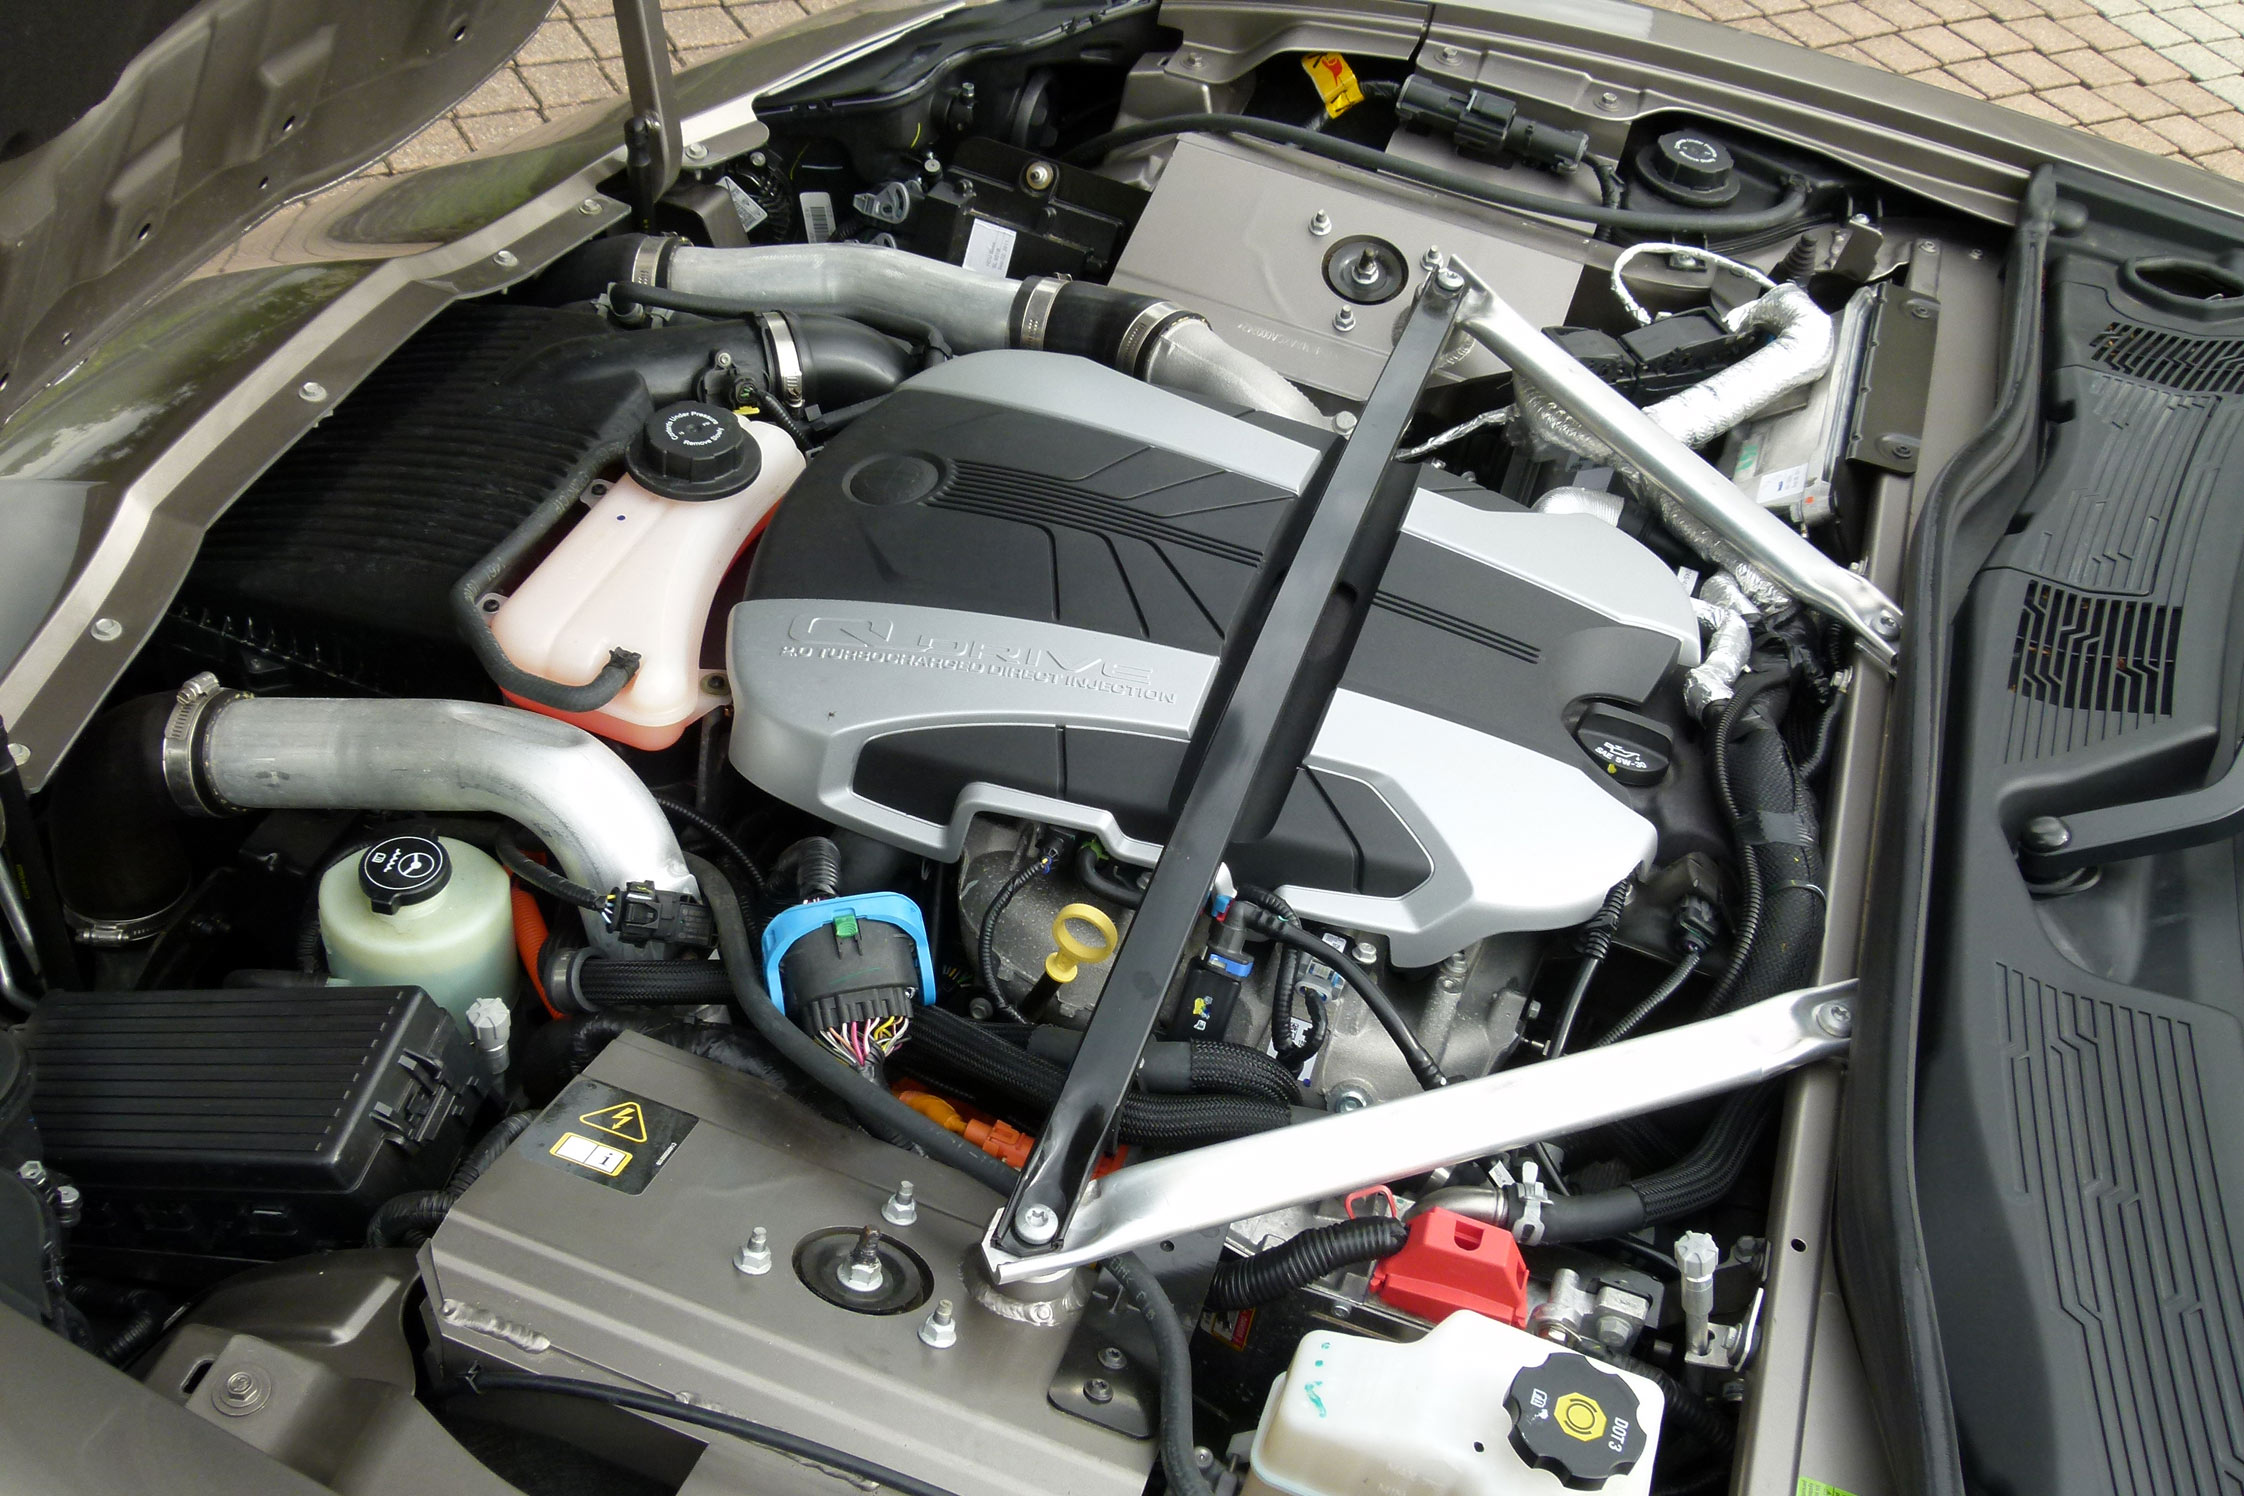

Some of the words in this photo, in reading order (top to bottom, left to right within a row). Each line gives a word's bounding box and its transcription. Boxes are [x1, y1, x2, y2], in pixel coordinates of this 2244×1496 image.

[669, 412, 690, 422] Under
[780, 645, 813, 658] 2.0
[818, 646, 985, 674] TURBOCHARGED
[987, 662, 1063, 684] DIRECT
[1065, 675, 1176, 704] INJECTION
[1594, 746, 1615, 760] SAE
